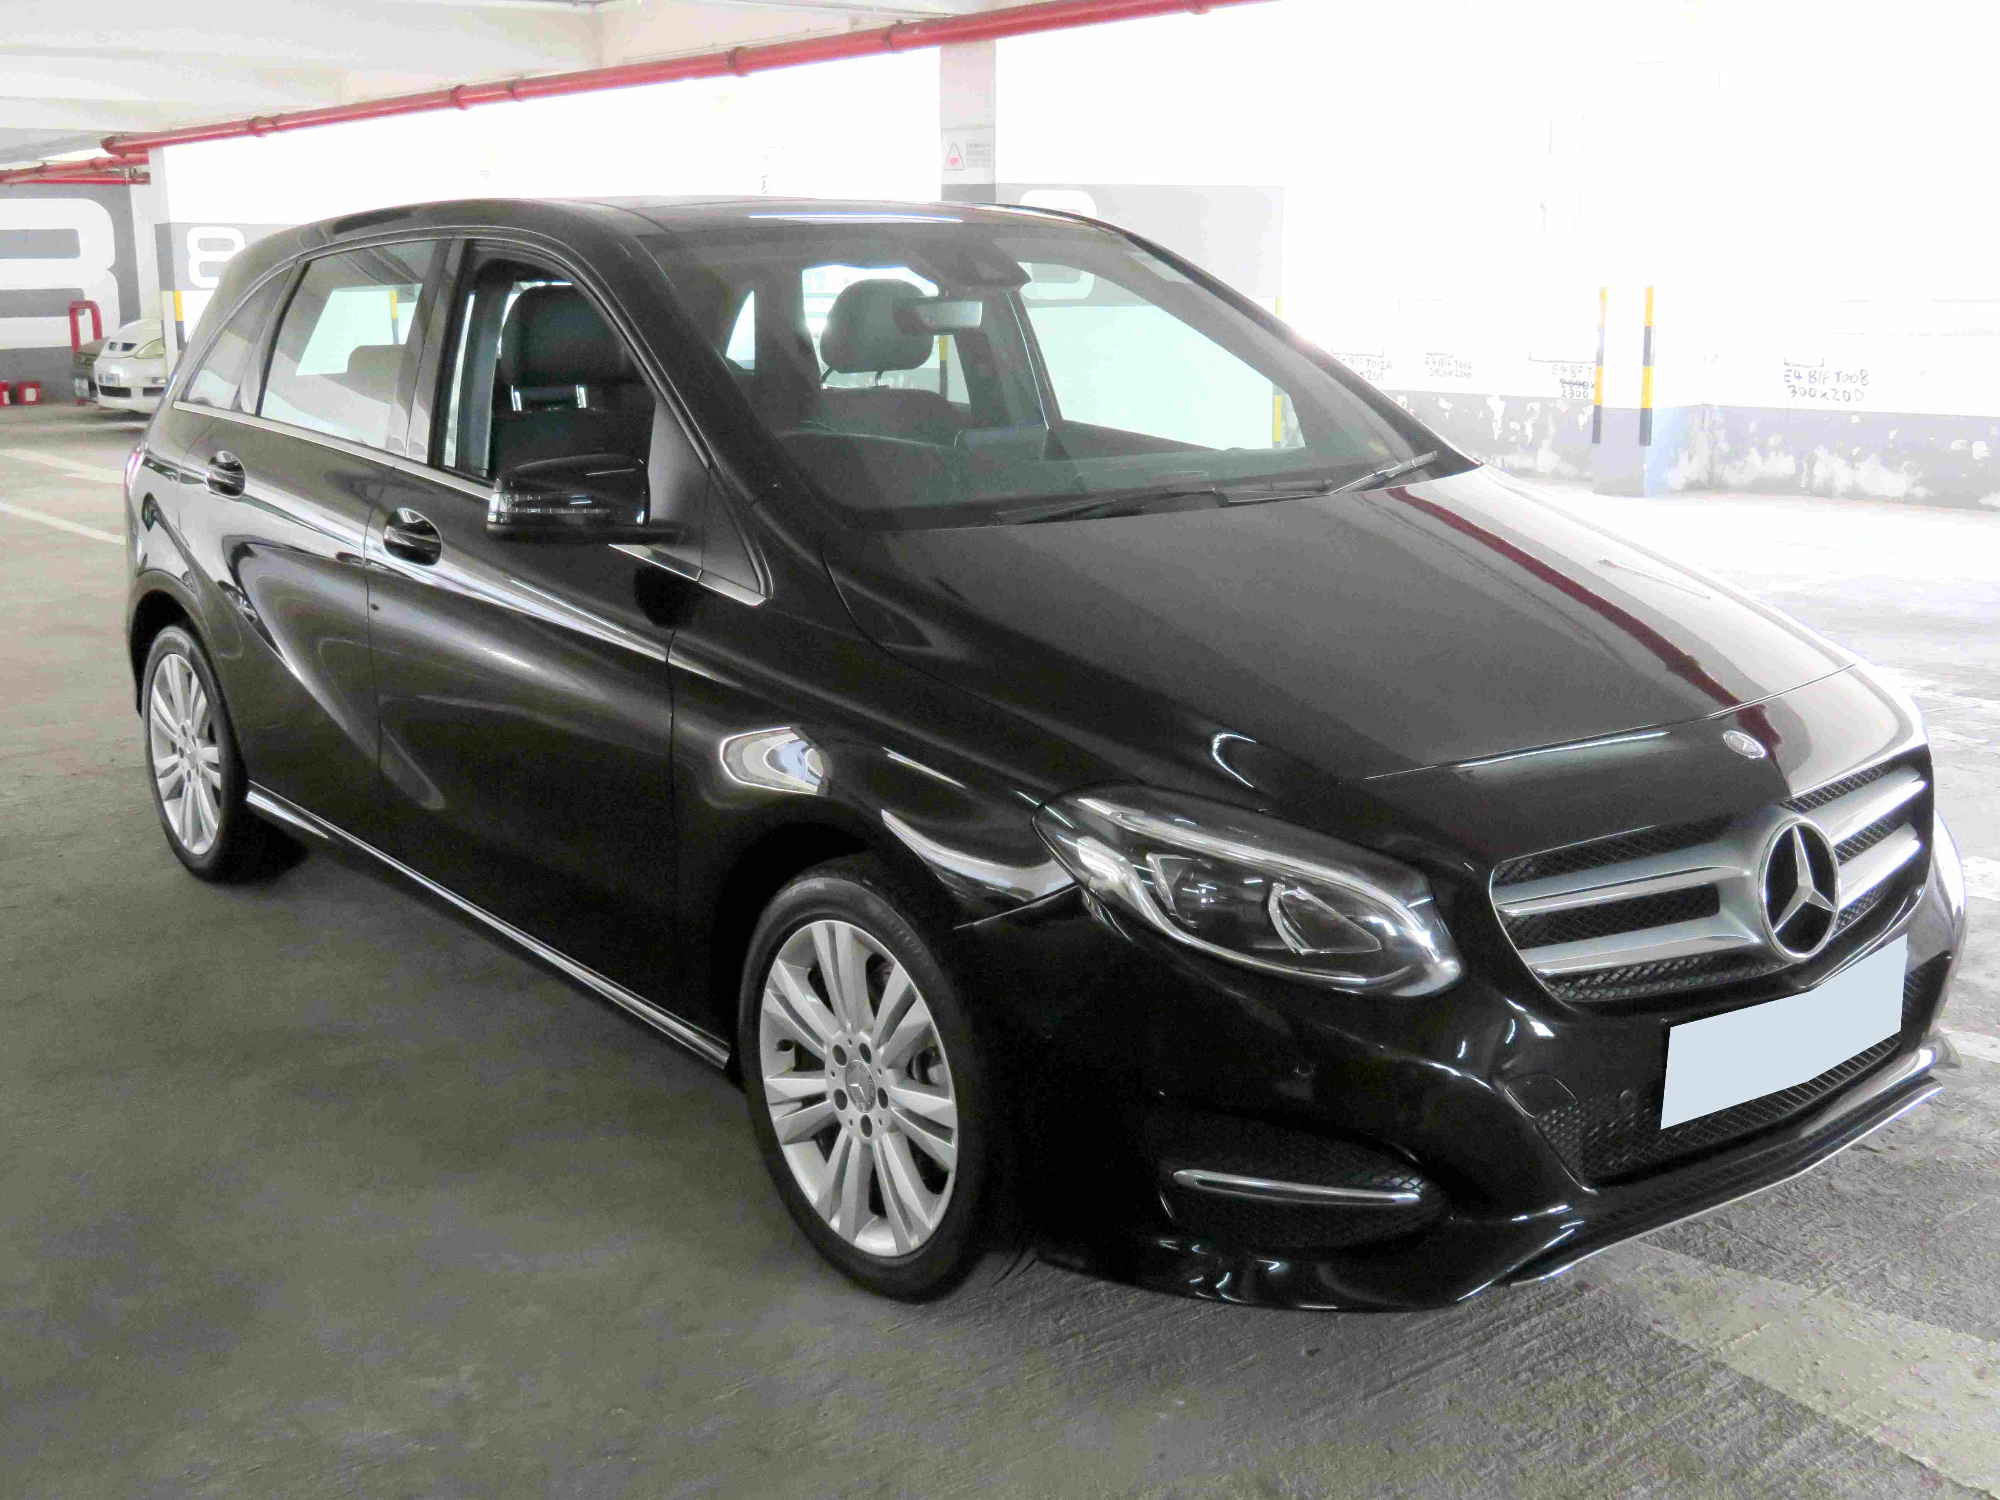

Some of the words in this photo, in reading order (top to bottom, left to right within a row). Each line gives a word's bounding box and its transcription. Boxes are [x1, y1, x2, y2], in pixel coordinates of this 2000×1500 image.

[187, 226, 246, 288] 8
[1784, 369, 1803, 383] E4
[1833, 368, 1870, 386] T008
[1561, 389, 1589, 398] 2300
[1787, 384, 1864, 402] 300x200
